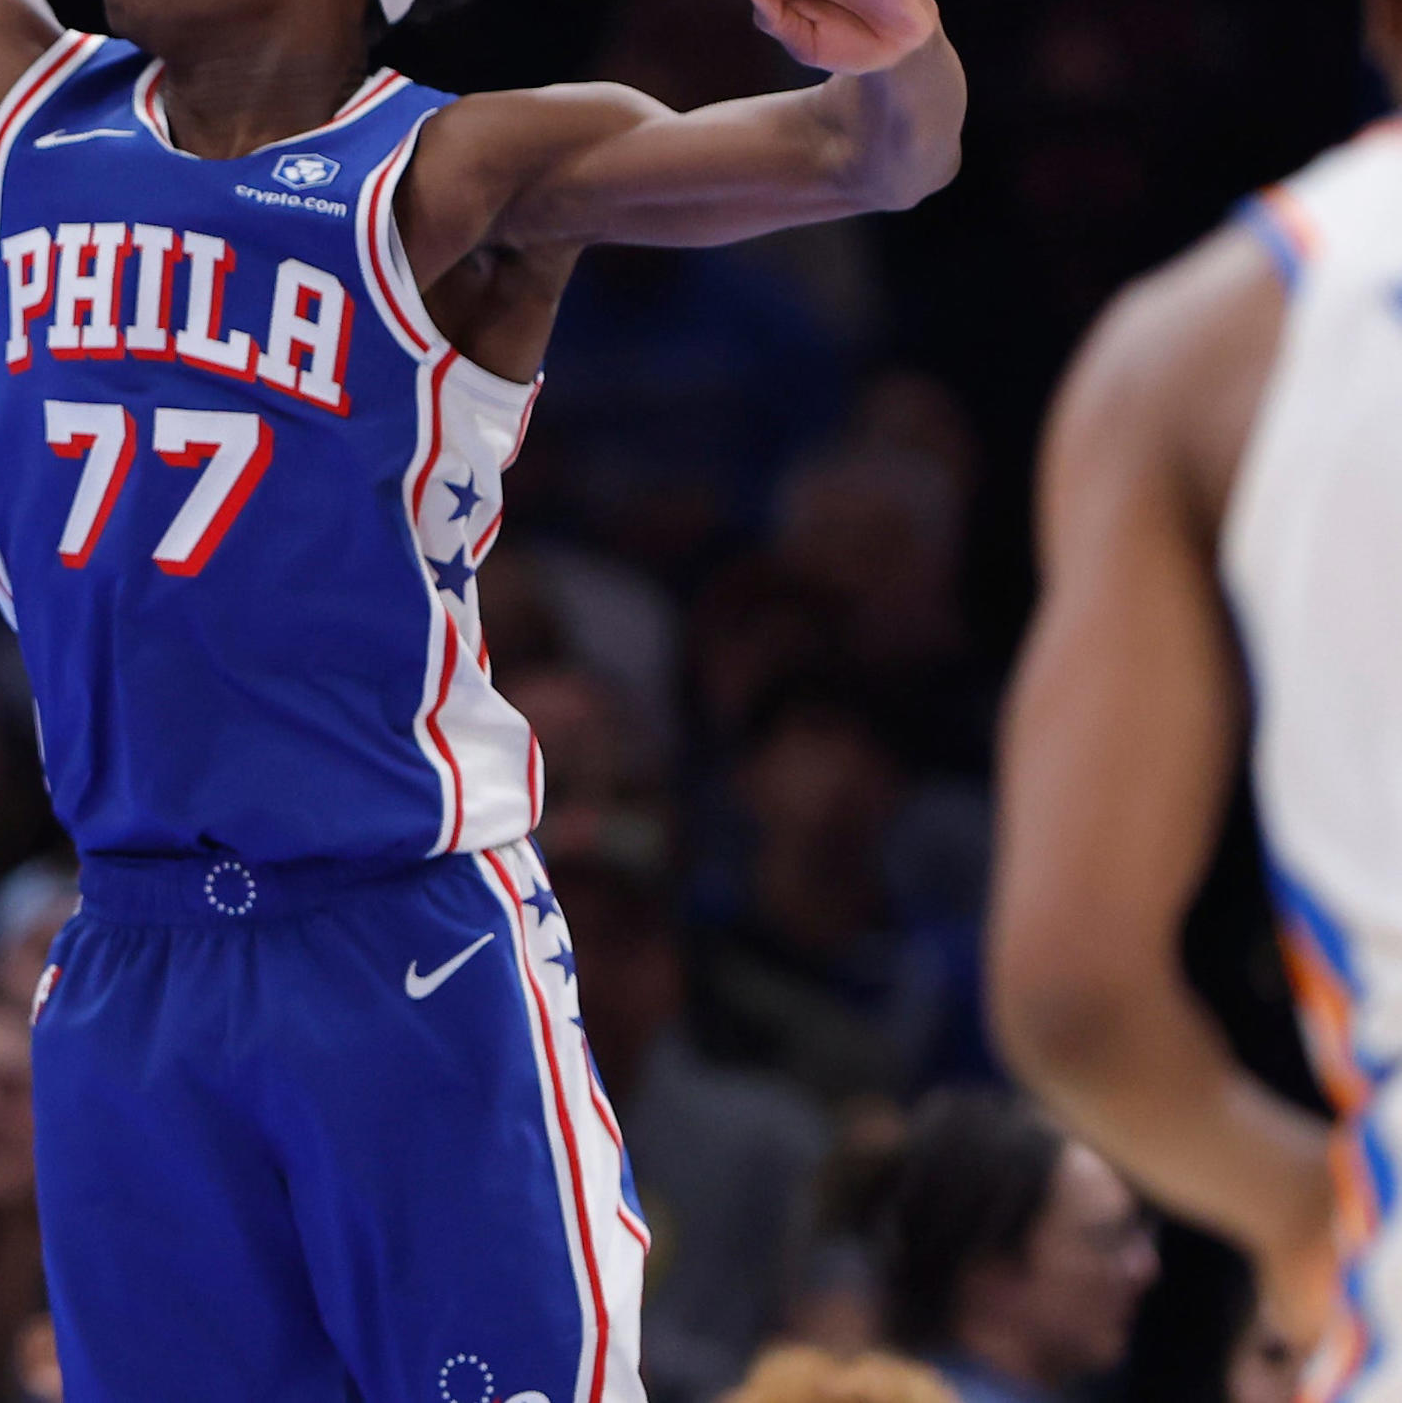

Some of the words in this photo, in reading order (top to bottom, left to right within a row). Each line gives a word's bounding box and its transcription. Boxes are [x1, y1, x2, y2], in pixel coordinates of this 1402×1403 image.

[234, 184, 348, 218] crypto.com
[1, 221, 355, 418] PHILA
[43, 399, 274, 578] 77
